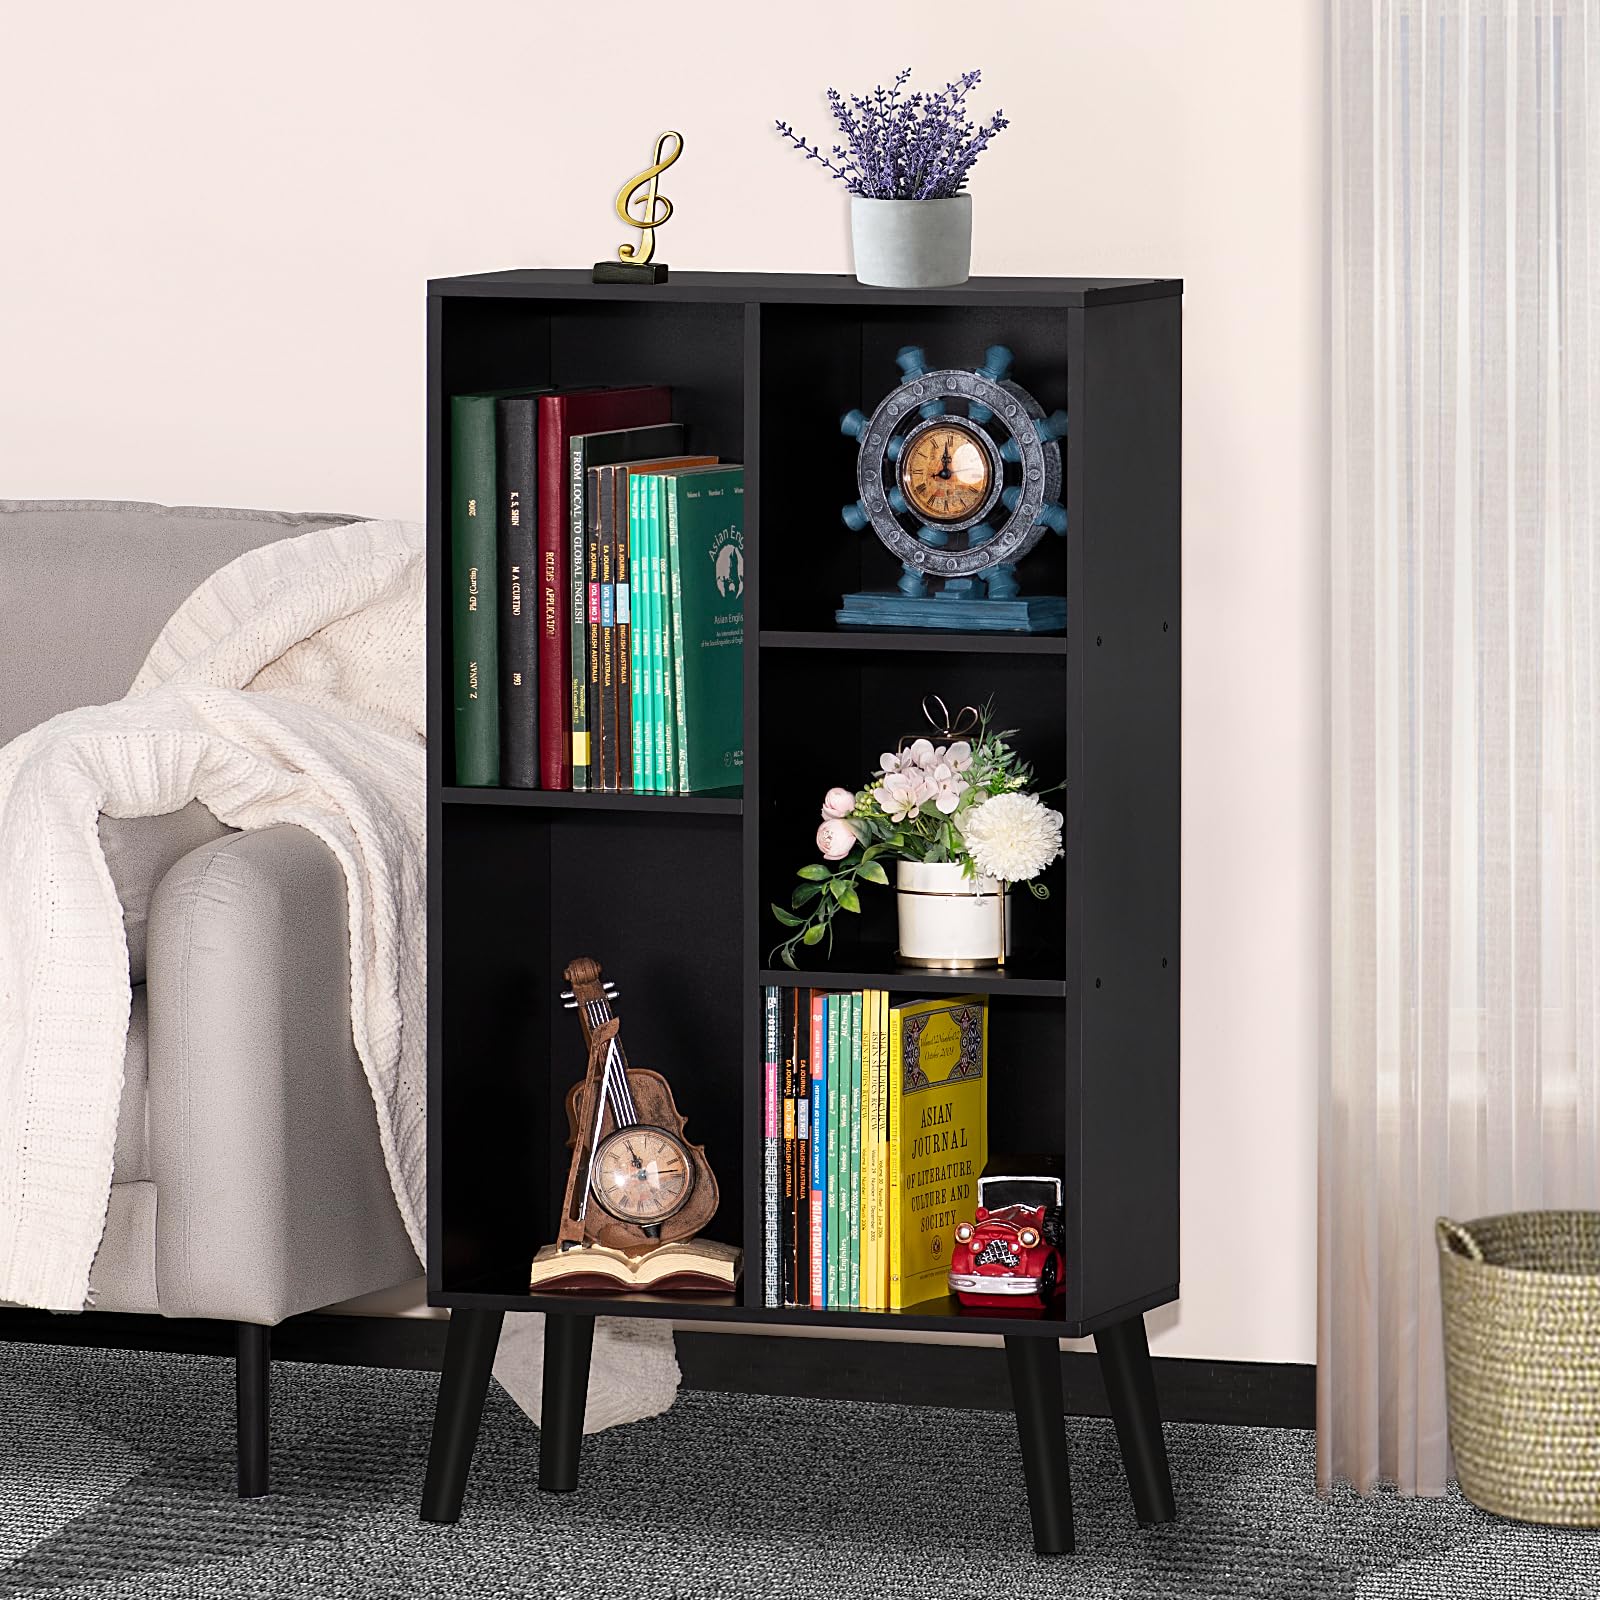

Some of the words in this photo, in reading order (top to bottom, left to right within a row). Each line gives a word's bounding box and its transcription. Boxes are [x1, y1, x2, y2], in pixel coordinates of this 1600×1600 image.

[573, 451, 583, 480] FROM
[510, 492, 519, 501] K.
[573, 483, 583, 517] LOCAL
[667, 492, 677, 512] Asian
[467, 499, 477, 517] 2006
[510, 509, 519, 526] SHIN
[573, 520, 583, 532] TO
[668, 512, 679, 548] Englishes
[590, 542, 598, 552] EA
[603, 544, 610, 554] EA
[618, 543, 626, 553] EA
[708, 528, 730, 562] Asian
[573, 536, 583, 577] GLOBAL
[590, 552, 598, 580] JOURNAL
[512, 566, 521, 574] M
[618, 553, 626, 582] JOURNAL
[468, 567, 479, 595] (Curtin)
[592, 583, 600, 595] VOL
[672, 573, 680, 592] Volume
[512, 582, 521, 616] (CURTIN)
[592, 595, 600, 604] 24
[603, 586, 611, 598] VOL
[468, 597, 477, 612] PhD
[573, 580, 584, 625] ENGLISH
[592, 605, 600, 616] NO
[603, 608, 611, 617] NO
[713, 615, 728, 625] Asian
[591, 623, 600, 648] ENGLISH
[604, 627, 612, 652] ENGLISH
[620, 624, 629, 649] ENGLISH
[469, 661, 478, 689] ADNAN
[591, 650, 600, 684] AUSTRALIA
[604, 653, 612, 687] AUSTRALIA
[620, 650, 629, 685] AUSTRALIA
[512, 672, 522, 686] 1993
[469, 690, 478, 699] Z.
[767, 996, 777, 1010] EA
[828, 1009, 839, 1029] Asian
[852, 1007, 861, 1026] Asian
[767, 1013, 777, 1055] JOURNAL
[840, 1025, 849, 1037] ALC
[828, 1030, 839, 1063] Englishes
[851, 1027, 862, 1061] Englishes
[785, 1059, 794, 1068] EA
[800, 1059, 808, 1068] EA
[785, 1068, 794, 1096] JOURNAL
[800, 1068, 808, 1097] JOURNAL
[785, 1101, 793, 1113] VOL
[799, 1101, 808, 1113] VOL
[829, 1089, 837, 1108] Volume
[840, 1094, 848, 1109] 2004
[853, 1087, 861, 1107] Volume
[814, 1109, 820, 1118] OF
[840, 1109, 848, 1128] Winter
[921, 1102, 953, 1129] ASIAN
[785, 1122, 793, 1132] NO
[799, 1122, 808, 1133] NO
[851, 1125, 860, 1148] Number
[784, 1138, 793, 1162] ENGLISH
[814, 1145, 820, 1153] OF
[829, 1129, 837, 1151] Number
[911, 1127, 968, 1160] JOURNAL
[799, 1140, 808, 1165] ENGLISH
[784, 1163, 793, 1198] AUSTRALIA
[799, 1166, 808, 1200] AUSTRALIA
[851, 1171, 859, 1189] Winter
[906, 1173, 916, 1190] OF
[917, 1160, 975, 1187] LITERATURE,
[850, 1190, 860, 1224] 2003/Spring
[911, 1188, 948, 1212] CULTURE
[949, 1183, 970, 1202] AND
[811, 1200, 822, 1257] WORLD-WIDE
[921, 1209, 957, 1233] SOCIETY
[851, 1225, 859, 1239] 2004
[839, 1238, 849, 1271] Englishes
[811, 1258, 822, 1297] ENGLISH
[829, 1264, 837, 1276] ALC
[851, 1262, 859, 1275] ALC
[839, 1272, 847, 1292] Asian
